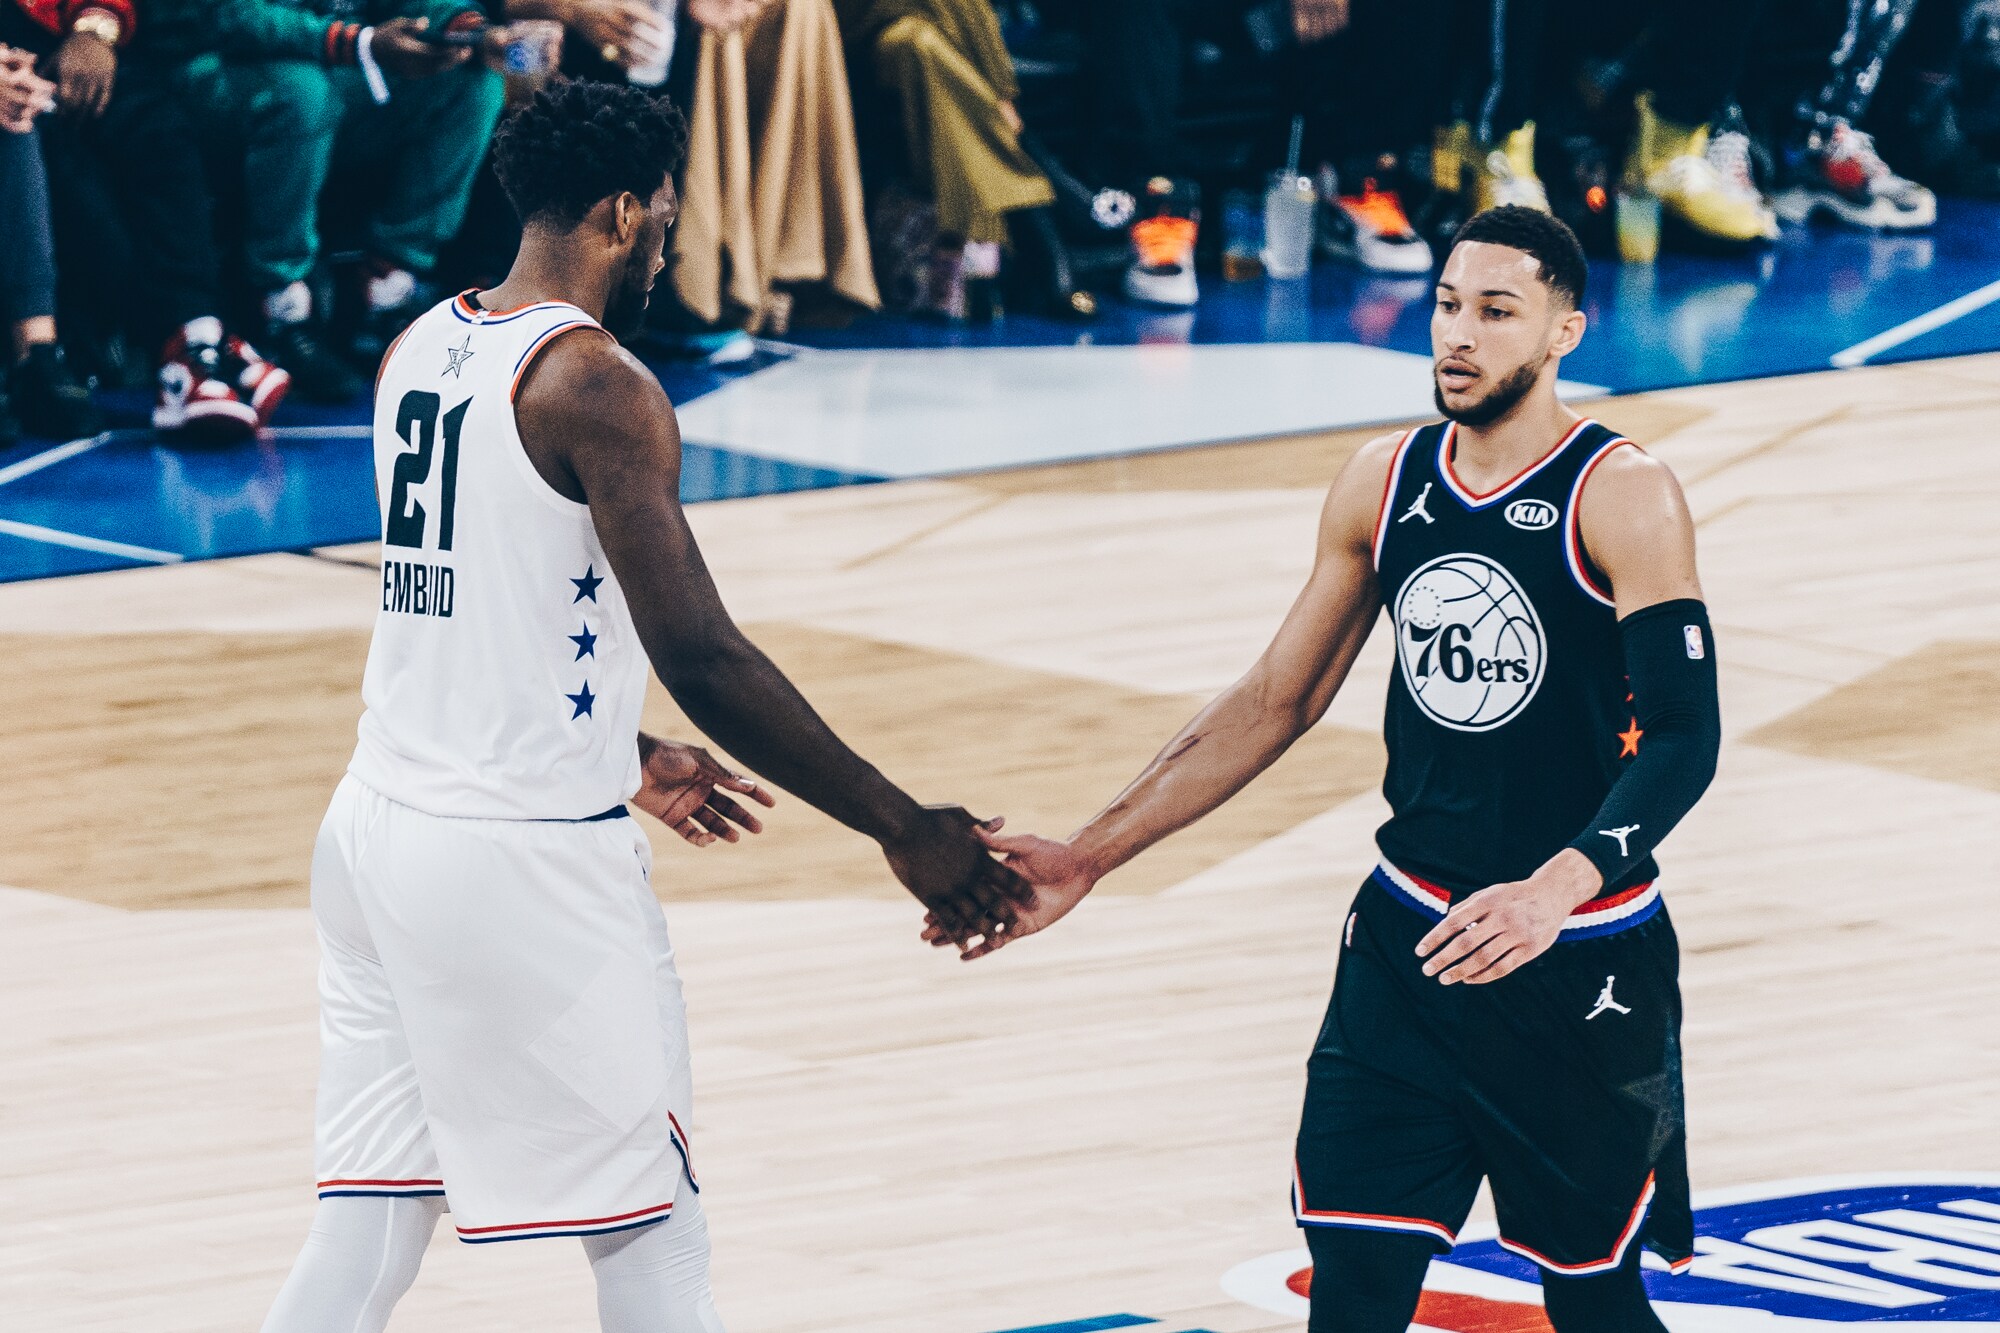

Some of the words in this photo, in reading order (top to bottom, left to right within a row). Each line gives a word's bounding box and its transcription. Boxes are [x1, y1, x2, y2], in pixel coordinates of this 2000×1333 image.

[386, 389, 474, 552] 21
[1512, 504, 1549, 525] KIA
[383, 560, 454, 618] EMBIID
[1408, 620, 1530, 684] 76ers
